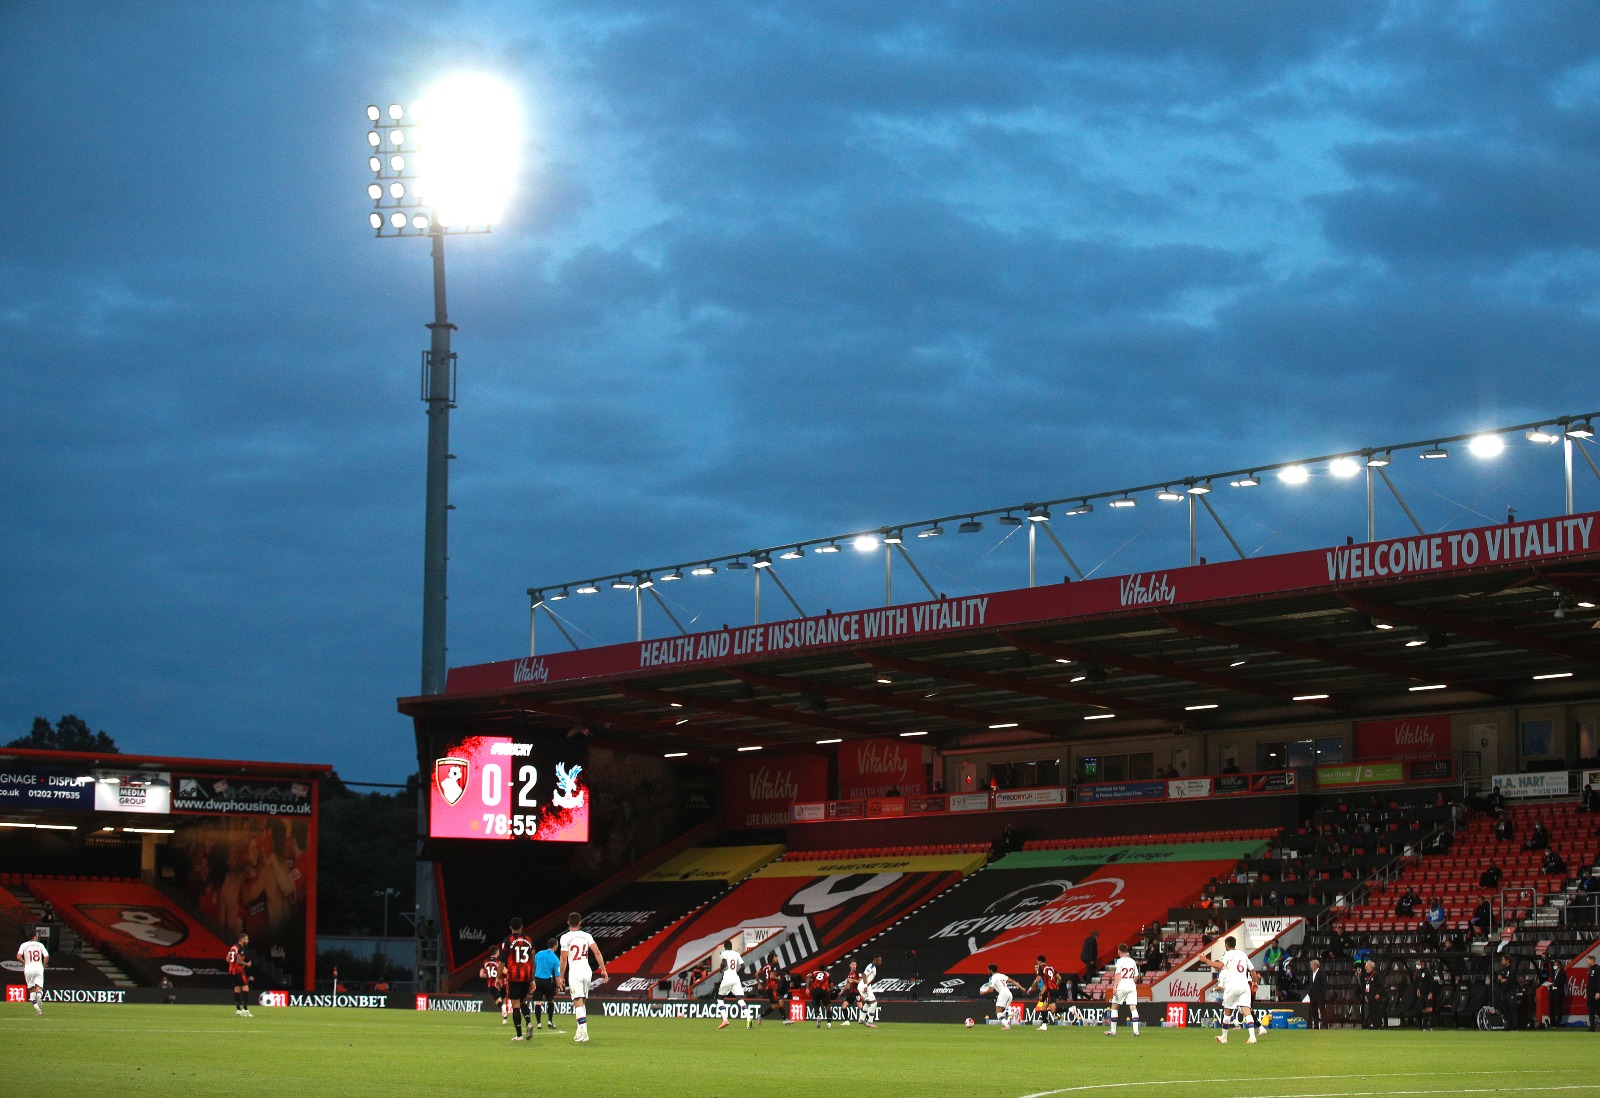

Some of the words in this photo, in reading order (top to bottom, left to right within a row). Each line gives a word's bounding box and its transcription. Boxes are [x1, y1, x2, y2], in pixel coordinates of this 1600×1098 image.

[1326, 536, 1442, 582] WELCOME
[1448, 532, 1479, 566] TO
[1484, 516, 1594, 561] VITALITY
[1120, 574, 1176, 606] Vitality
[640, 637, 694, 667] HEALTH
[696, 632, 730, 660] AND
[734, 627, 764, 655] LIFE
[768, 614, 860, 650] INSURANCE
[864, 608, 908, 638] WITH
[912, 597, 988, 632] VITALITY
[513, 657, 549, 684] Vitality
[1394, 722, 1434, 750] Vitality
[857, 740, 908, 782] Vitality
[482, 764, 502, 806] 0
[518, 765, 538, 807] 2
[750, 766, 798, 802] Vitality
[1519, 776, 1545, 788] HART
[28, 789, 52, 798] 01202
[54, 791, 80, 800] 717535
[120, 788, 146, 797] MEDIA
[850, 787, 876, 799] HEALTH
[878, 784, 920, 798] INSRANCE
[174, 799, 312, 814] www.dwphousing.co.uk
[483, 814, 536, 836] 78:55
[746, 814, 760, 826] LIFE
[1126, 852, 1174, 860] League
[1009, 894, 1067, 912] Thank
[1262, 920, 1281, 933] WV2
[460, 926, 486, 943] Vitality
[755, 930, 769, 940] WV1
[28, 950, 40, 962] 18
[515, 946, 529, 963] 13
[570, 944, 588, 961] 24
[487, 966, 498, 978] 16
[730, 960, 736, 970] 8
[1237, 959, 1245, 973] 6
[816, 972, 825, 981] 8
[1047, 970, 1054, 980] 9
[1121, 968, 1134, 979] 22
[673, 978, 688, 992] Vita
[1564, 975, 1587, 996] Vitali
[28, 990, 125, 1003] ANSIONBET
[290, 994, 387, 1008] MANSIONBET
[428, 999, 483, 1013] MANSIONBET
[603, 1002, 630, 1016] YOUR
[632, 1003, 688, 1018] FAVOURITE
[690, 1004, 721, 1018] PLACE
[725, 1004, 738, 1018] TO
